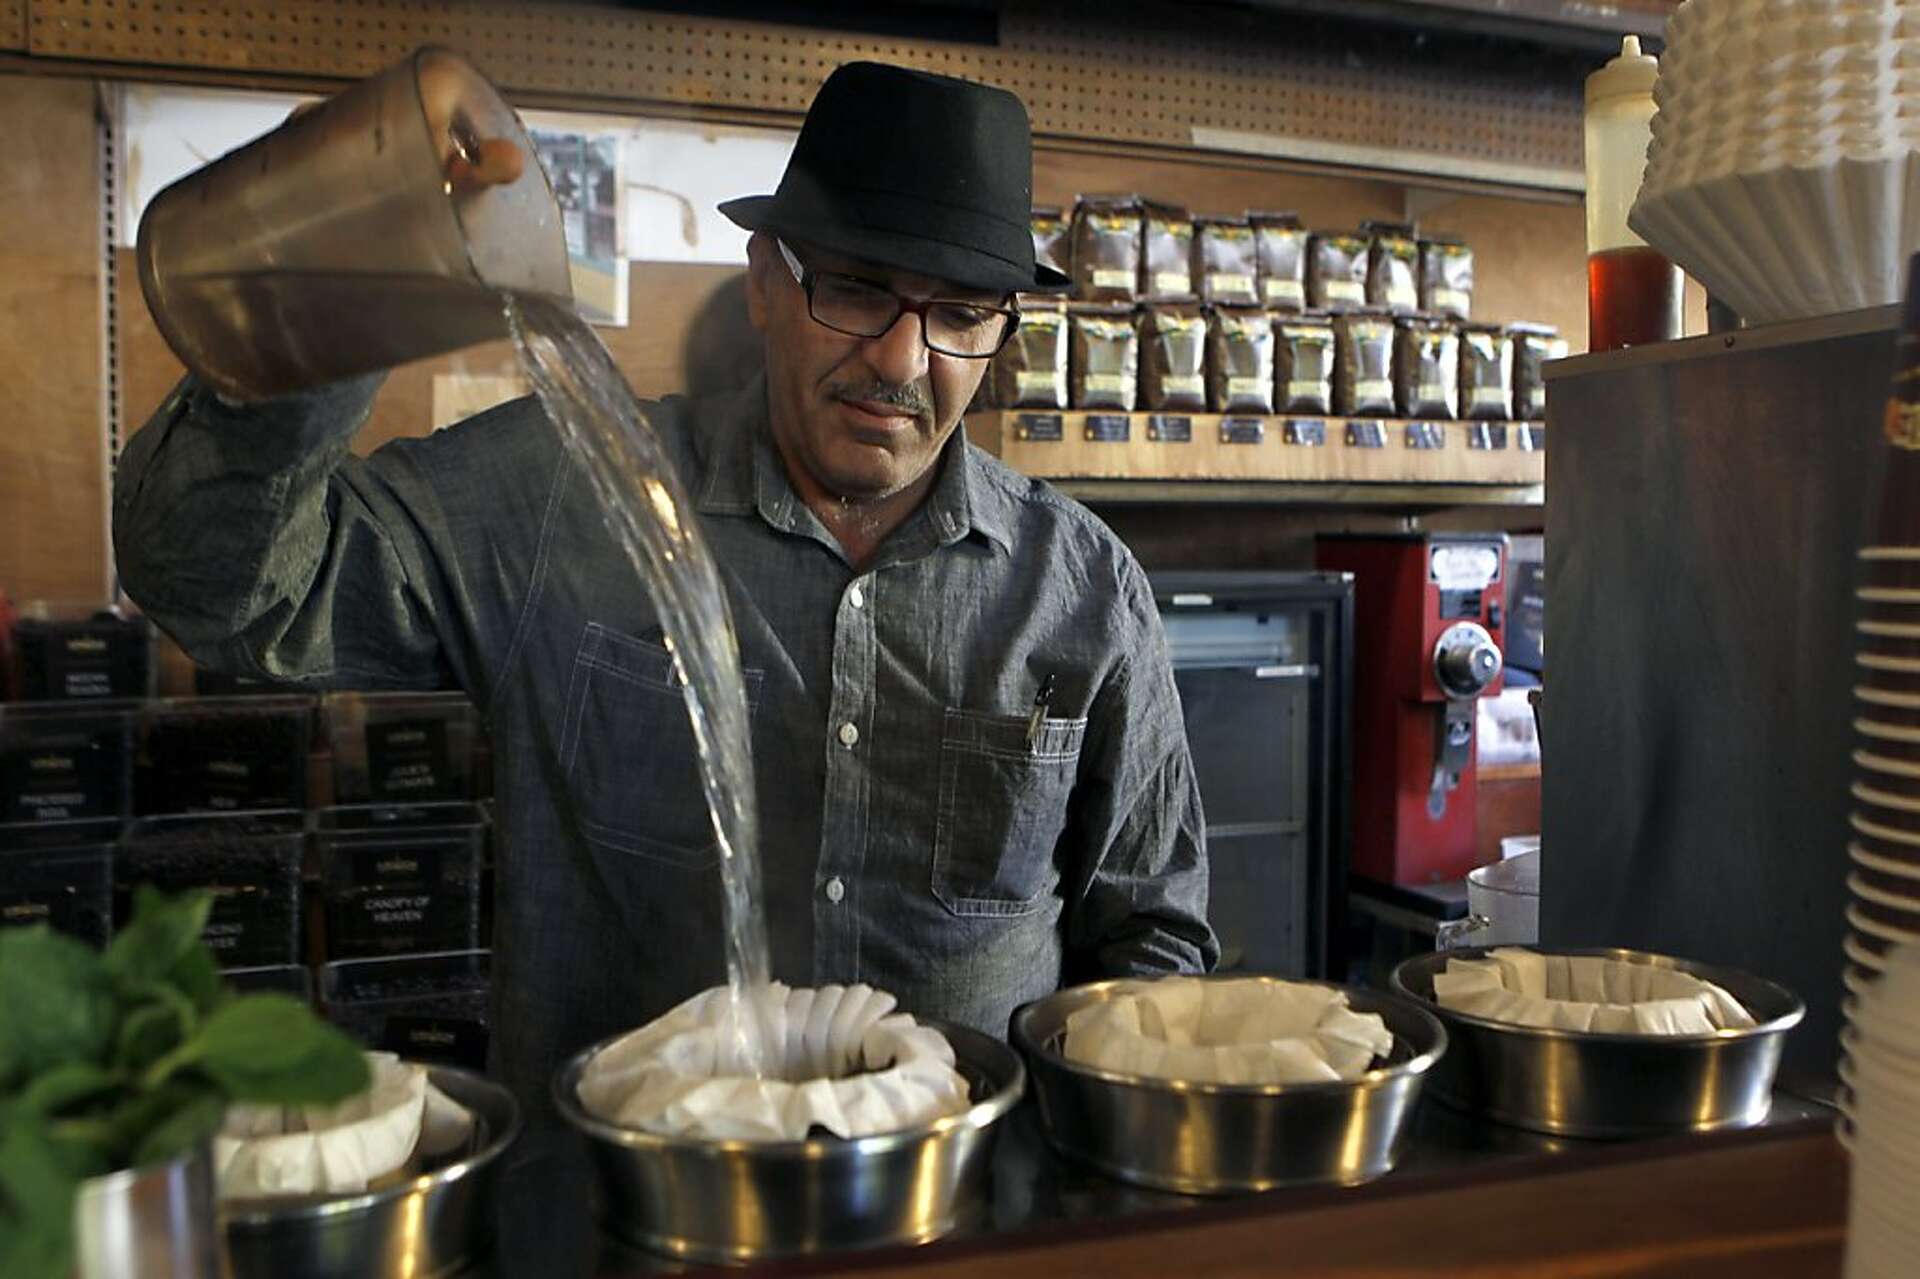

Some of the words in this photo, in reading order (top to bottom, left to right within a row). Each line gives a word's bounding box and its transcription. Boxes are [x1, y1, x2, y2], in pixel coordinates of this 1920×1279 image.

[364, 898, 412, 910] CANOPY
[414, 896, 431, 907] OF
[373, 910, 422, 922] HEAVEN
